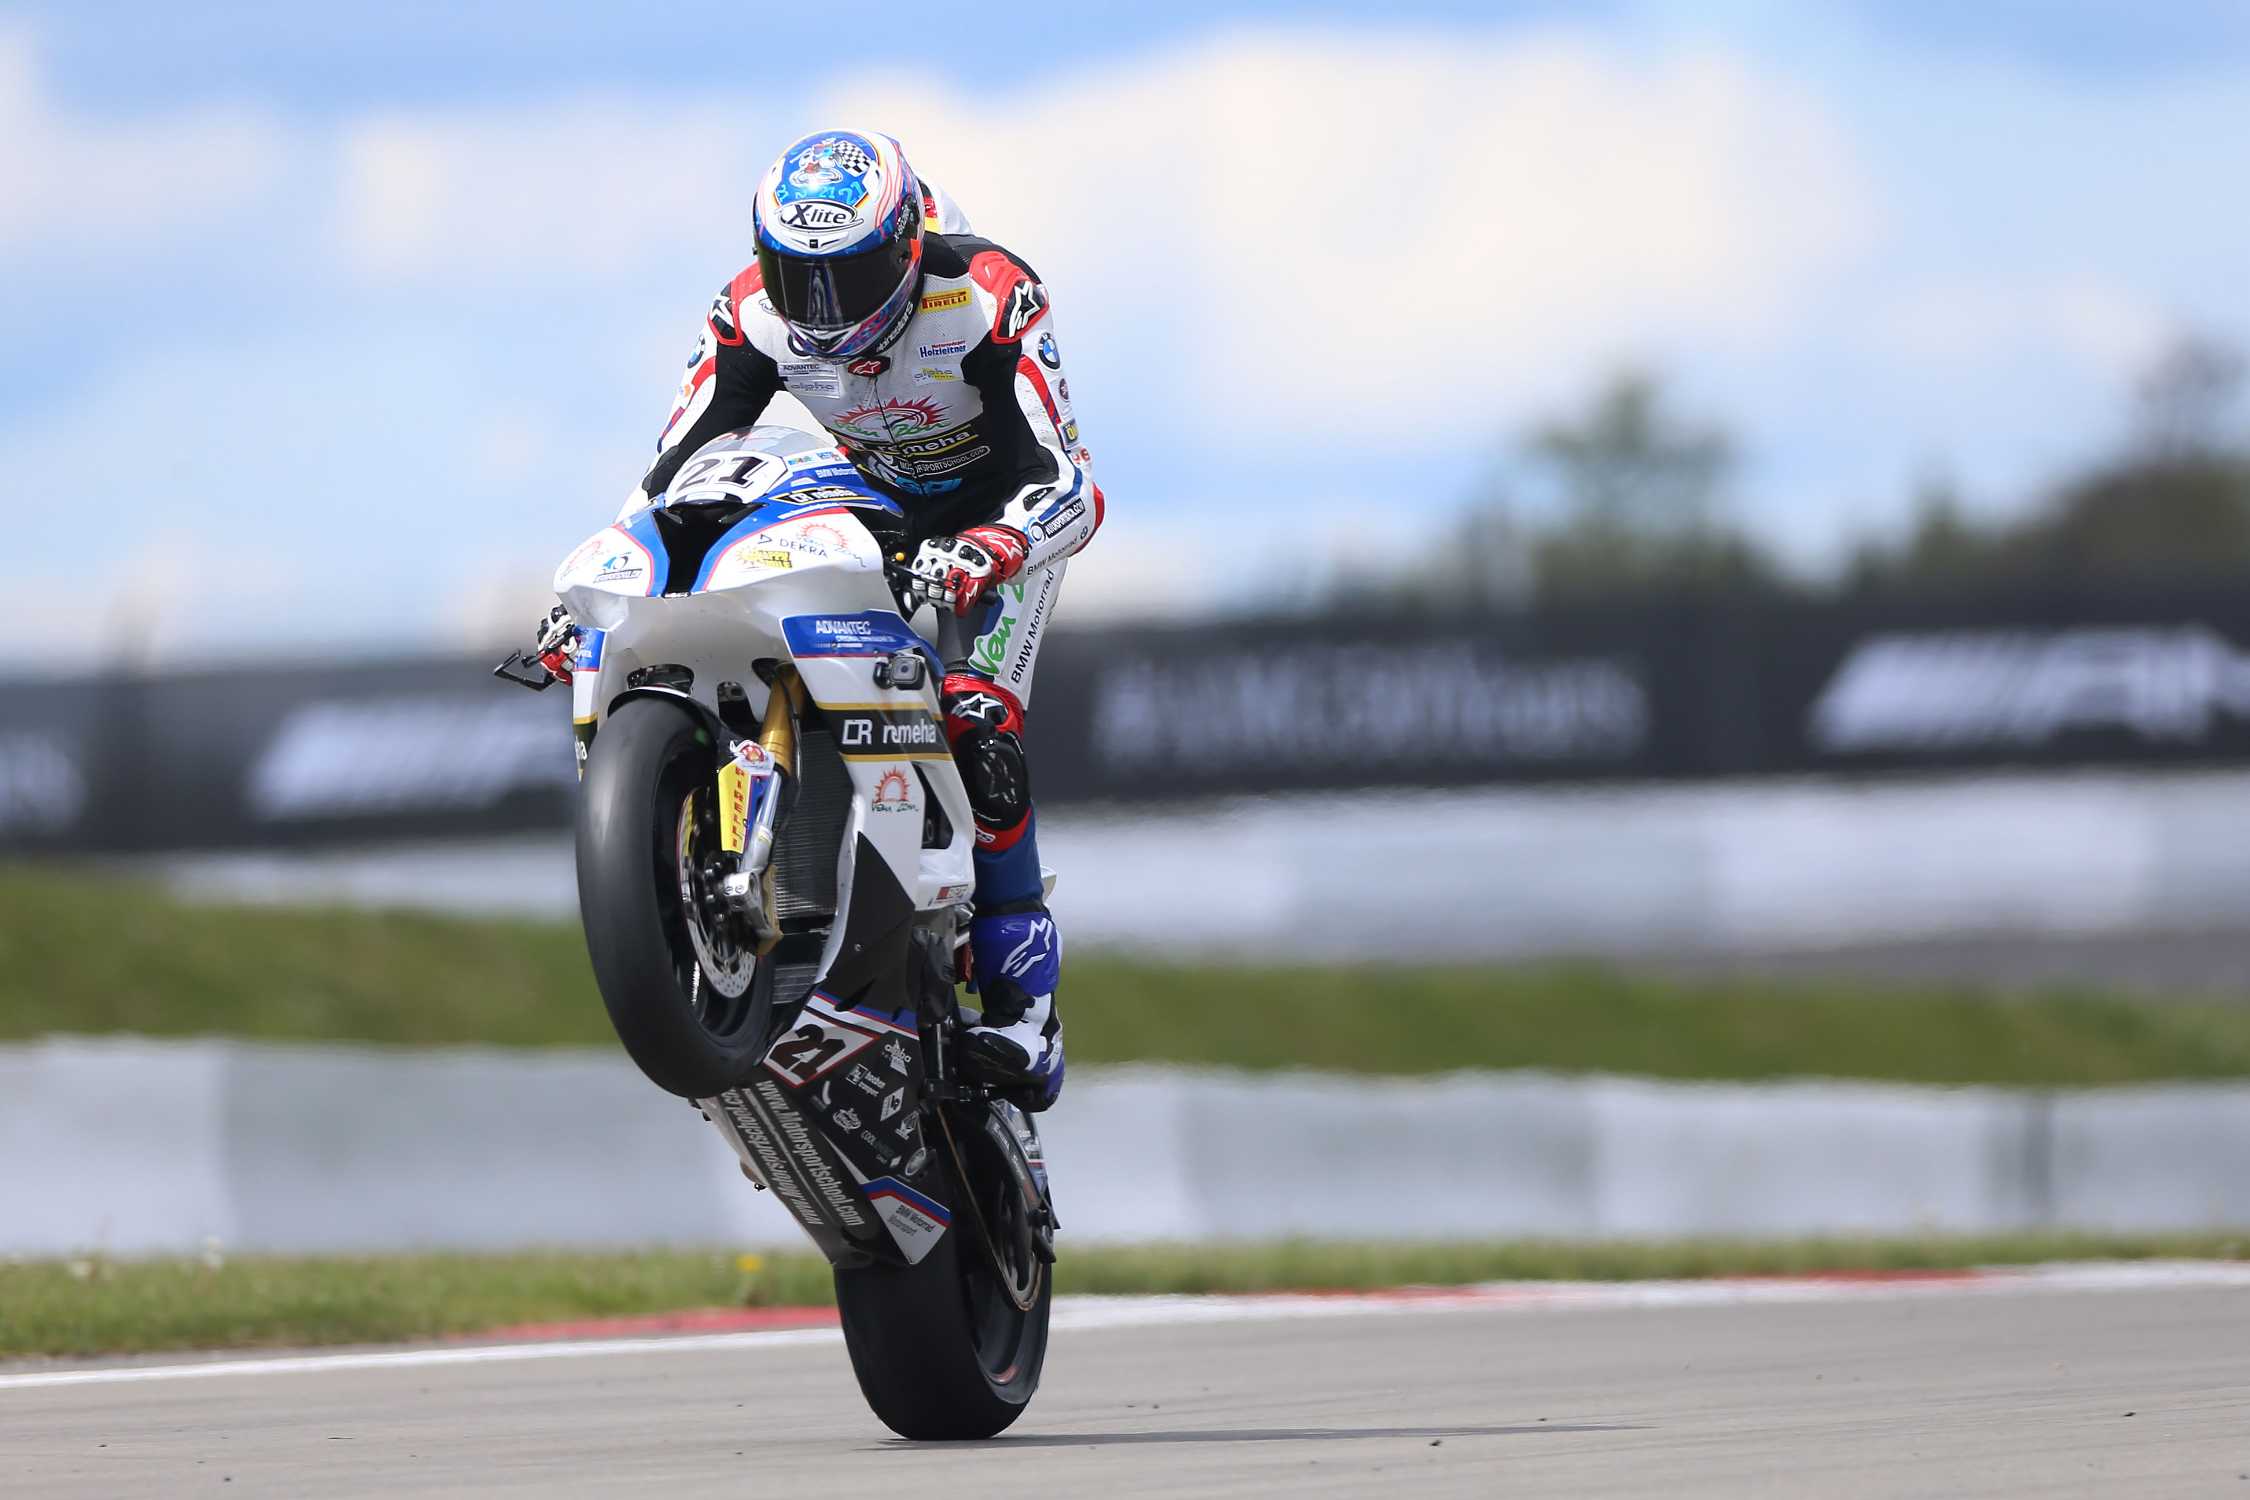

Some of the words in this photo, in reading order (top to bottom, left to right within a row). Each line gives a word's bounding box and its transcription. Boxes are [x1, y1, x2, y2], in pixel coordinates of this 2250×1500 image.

[786, 203, 847, 226] X-lite
[921, 291, 968, 310] PIRELLI
[919, 344, 967, 358] Holzleitner
[783, 363, 821, 371] ADVANTEC
[674, 456, 764, 493] 21
[779, 538, 829, 559] DEKRA
[815, 620, 872, 635] ADVANTEC
[1011, 639, 1034, 684] BMW
[1027, 568, 1055, 640] Motorrad
[769, 1024, 846, 1079] 21
[756, 1080, 865, 1227] www.Motorsportschool.com
